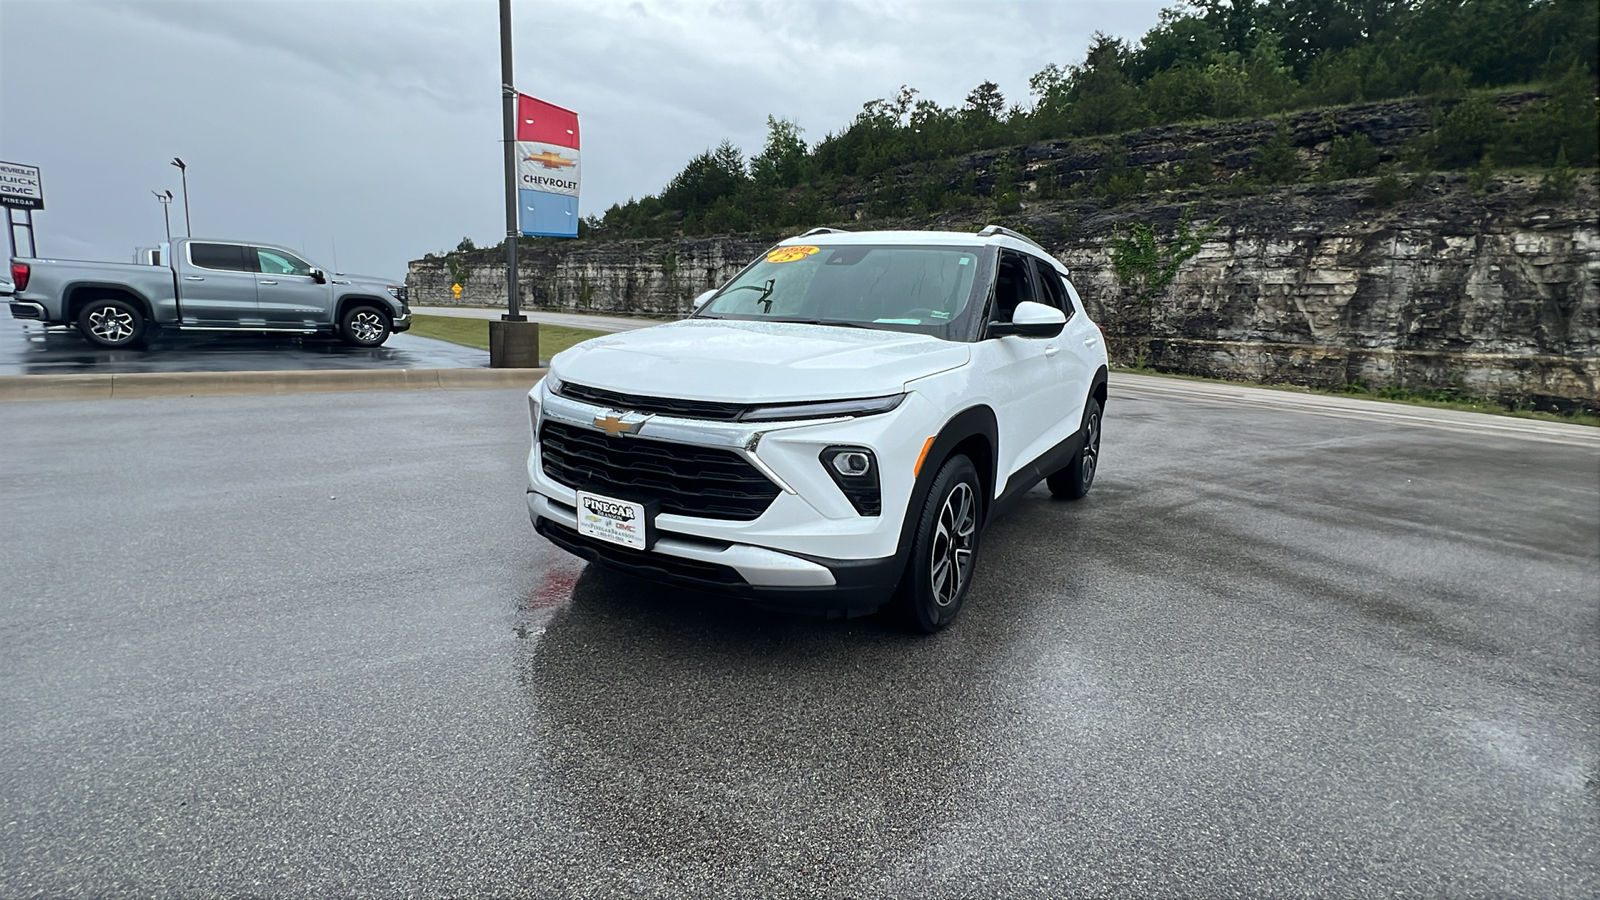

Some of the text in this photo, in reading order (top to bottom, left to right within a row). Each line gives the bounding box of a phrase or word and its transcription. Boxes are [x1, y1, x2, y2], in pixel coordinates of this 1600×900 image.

[0, 166, 35, 176] HEVROLET
[523, 174, 577, 190] CHEVROLET
[1, 185, 34, 195] GMC
[2, 196, 35, 206] PINEGAR
[584, 497, 635, 519] PINEGAR
[597, 510, 623, 521] BRANSON
[615, 522, 636, 533] GMC
